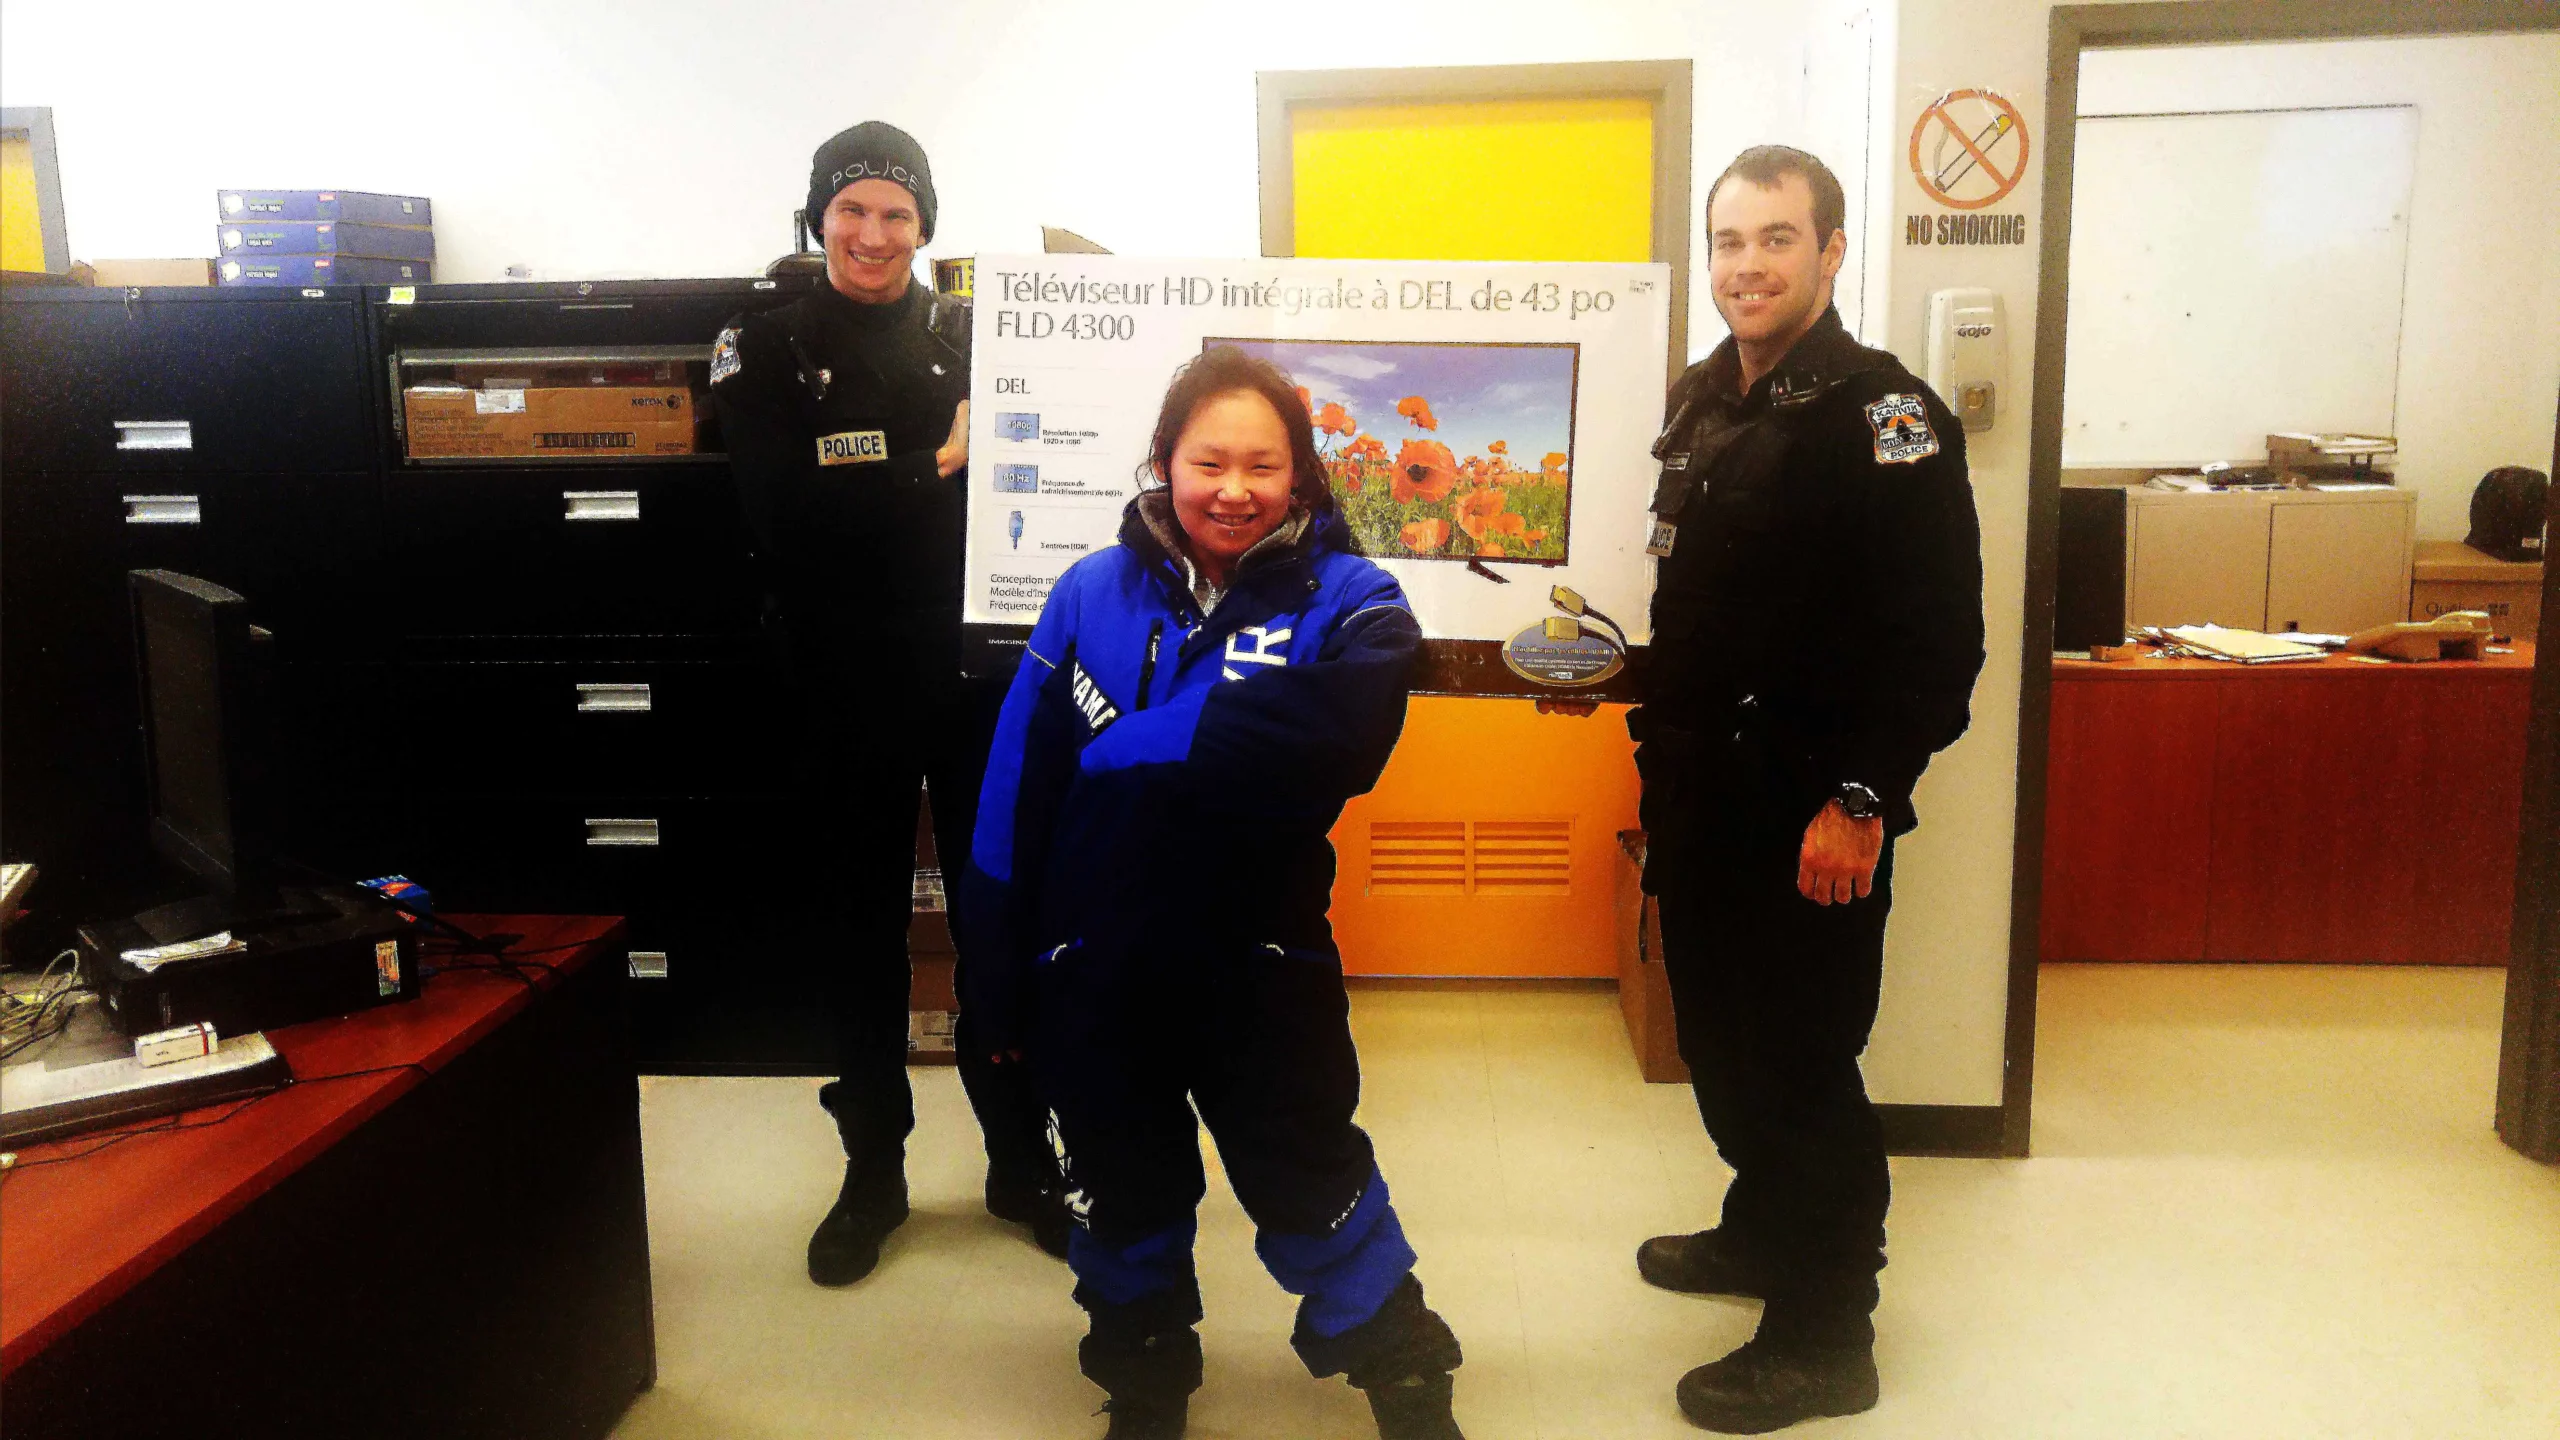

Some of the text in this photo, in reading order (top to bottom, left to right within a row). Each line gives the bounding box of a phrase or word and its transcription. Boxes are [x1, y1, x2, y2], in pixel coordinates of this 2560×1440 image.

[833, 160, 920, 193] POLICE
[1906, 214, 2026, 246] NO SMOKING
[996, 272, 1154, 306] Téléviseur
[1164, 276, 1213, 306] HD
[1222, 277, 1363, 315] intégrale
[1371, 278, 1389, 309] à
[1400, 280, 1462, 311] DEL
[1470, 280, 1513, 312] de
[1520, 282, 1560, 312] 43
[1569, 289, 1615, 321] po
[997, 310, 1135, 341] FLD 4300
[1957, 325, 1992, 338] GOJO
[996, 377, 1031, 395] DEL
[632, 397, 664, 406] xerox
[1876, 404, 1919, 418] KATIVIK
[823, 435, 882, 460] POLICE
[1890, 445, 1928, 459] POLICE
[990, 574, 1043, 586] Conception
[990, 587, 1025, 598] Modèle
[989, 601, 1038, 612] Fréquence
